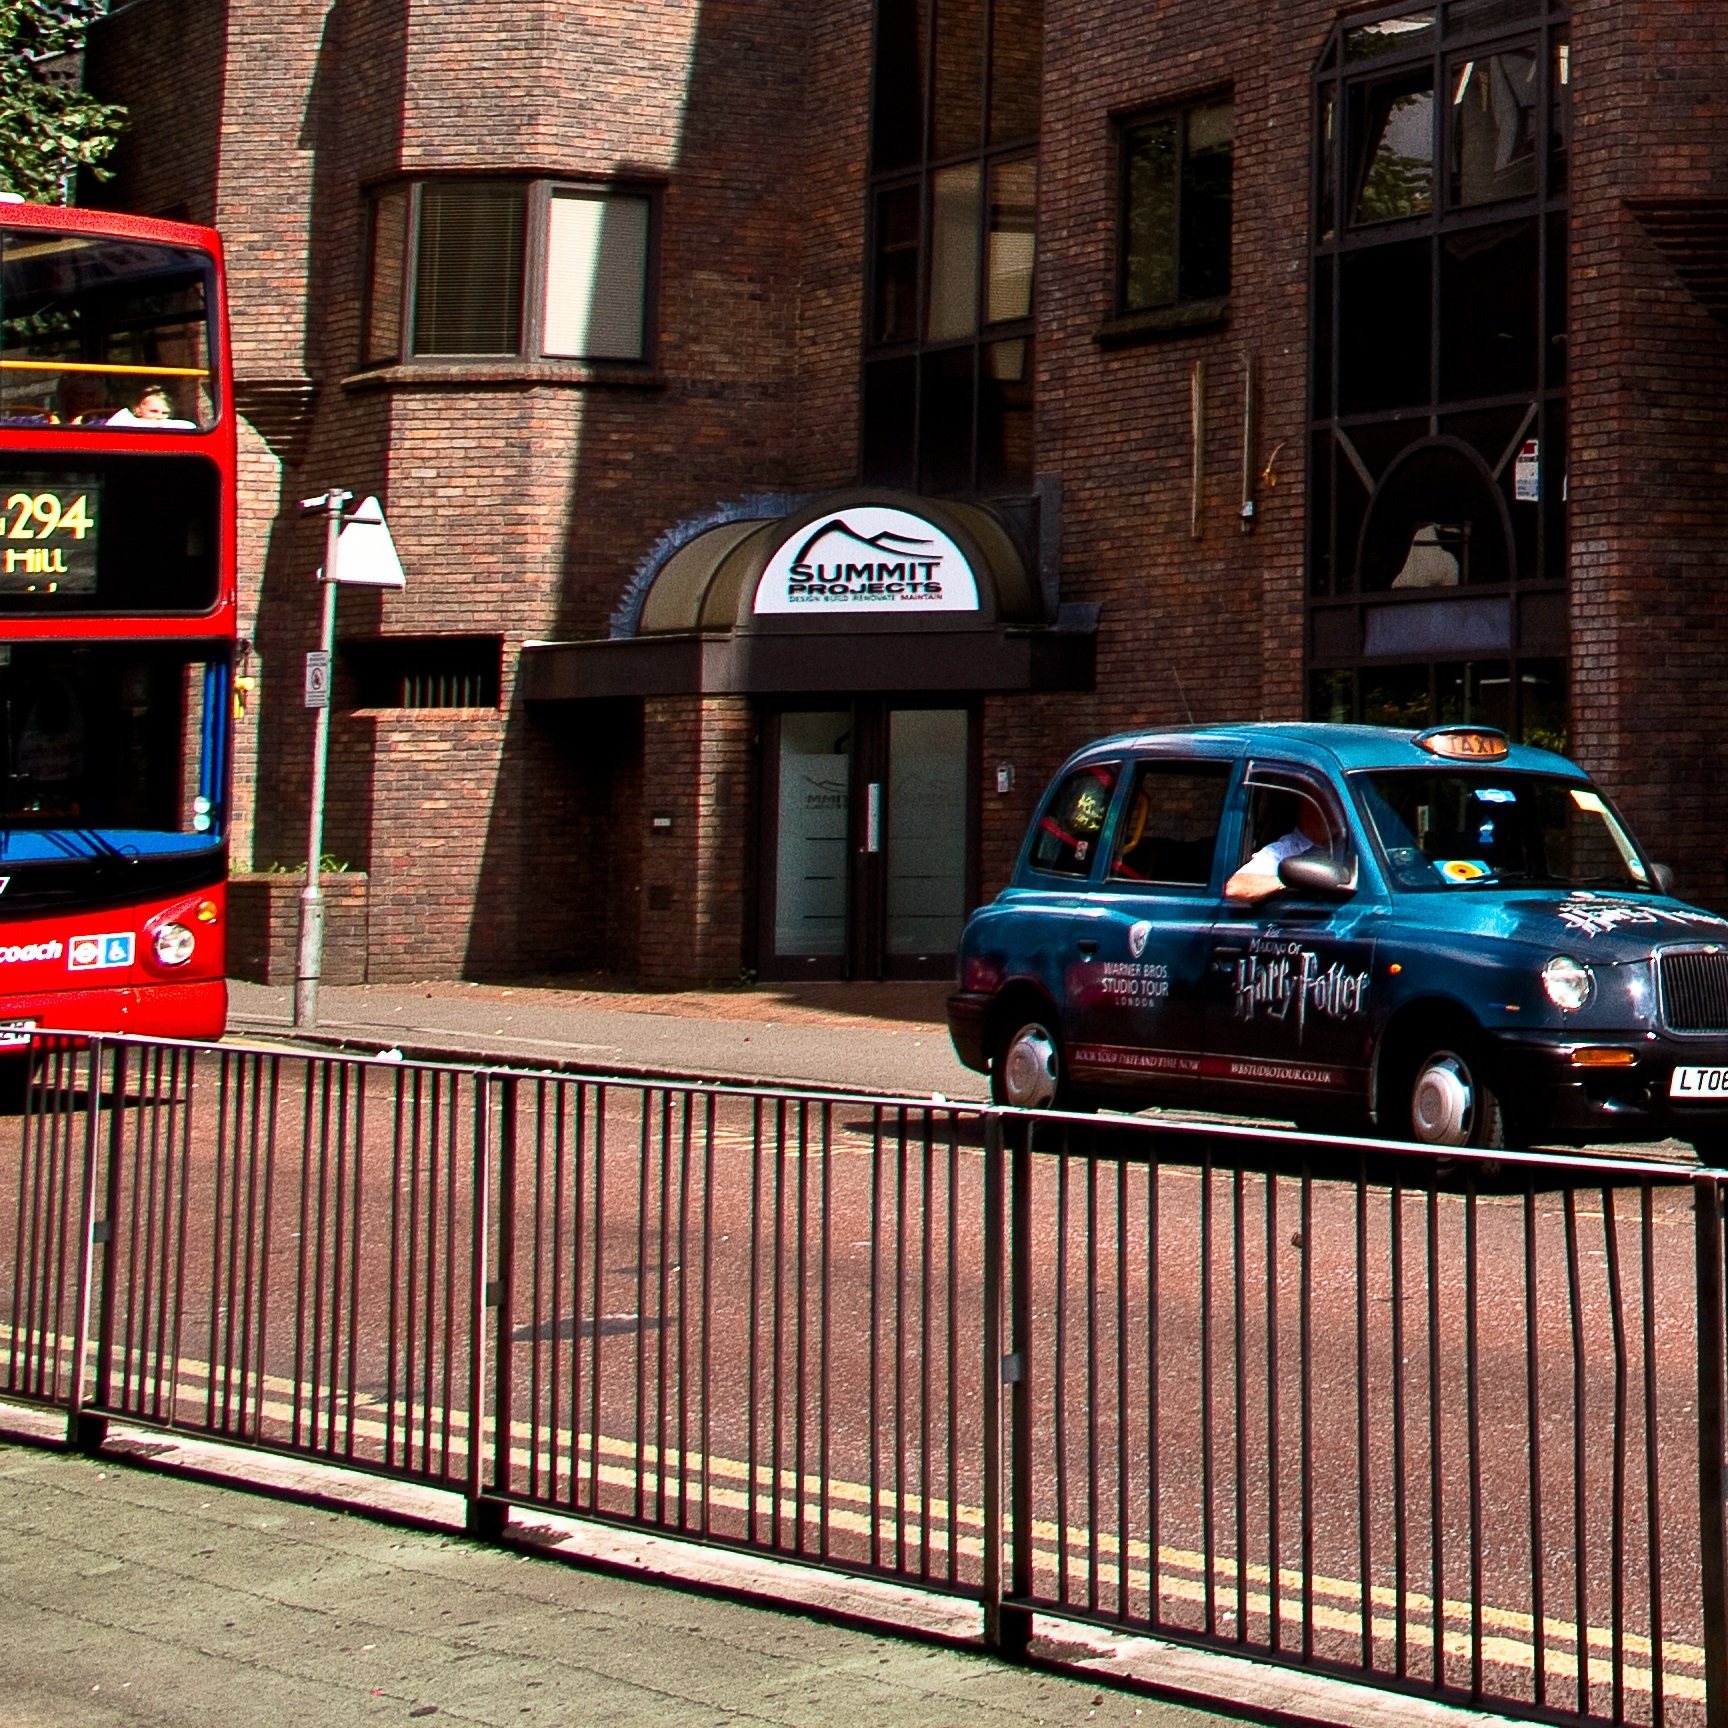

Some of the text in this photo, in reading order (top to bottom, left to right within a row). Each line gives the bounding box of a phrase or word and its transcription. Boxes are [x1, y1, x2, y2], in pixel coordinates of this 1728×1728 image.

[6, 493, 95, 539] 294
[5, 548, 68, 573] Hill
[788, 562, 941, 583] SUMMIT
[788, 582, 942, 595] PROJECTS
[1451, 736, 1495, 753] TAXI
[1104, 962, 1141, 977] WARNER
[1102, 977, 1169, 996] STUDIO TOUR
[1115, 997, 1154, 1007] LONDON
[1233, 952, 1371, 1047] Harry Potter
